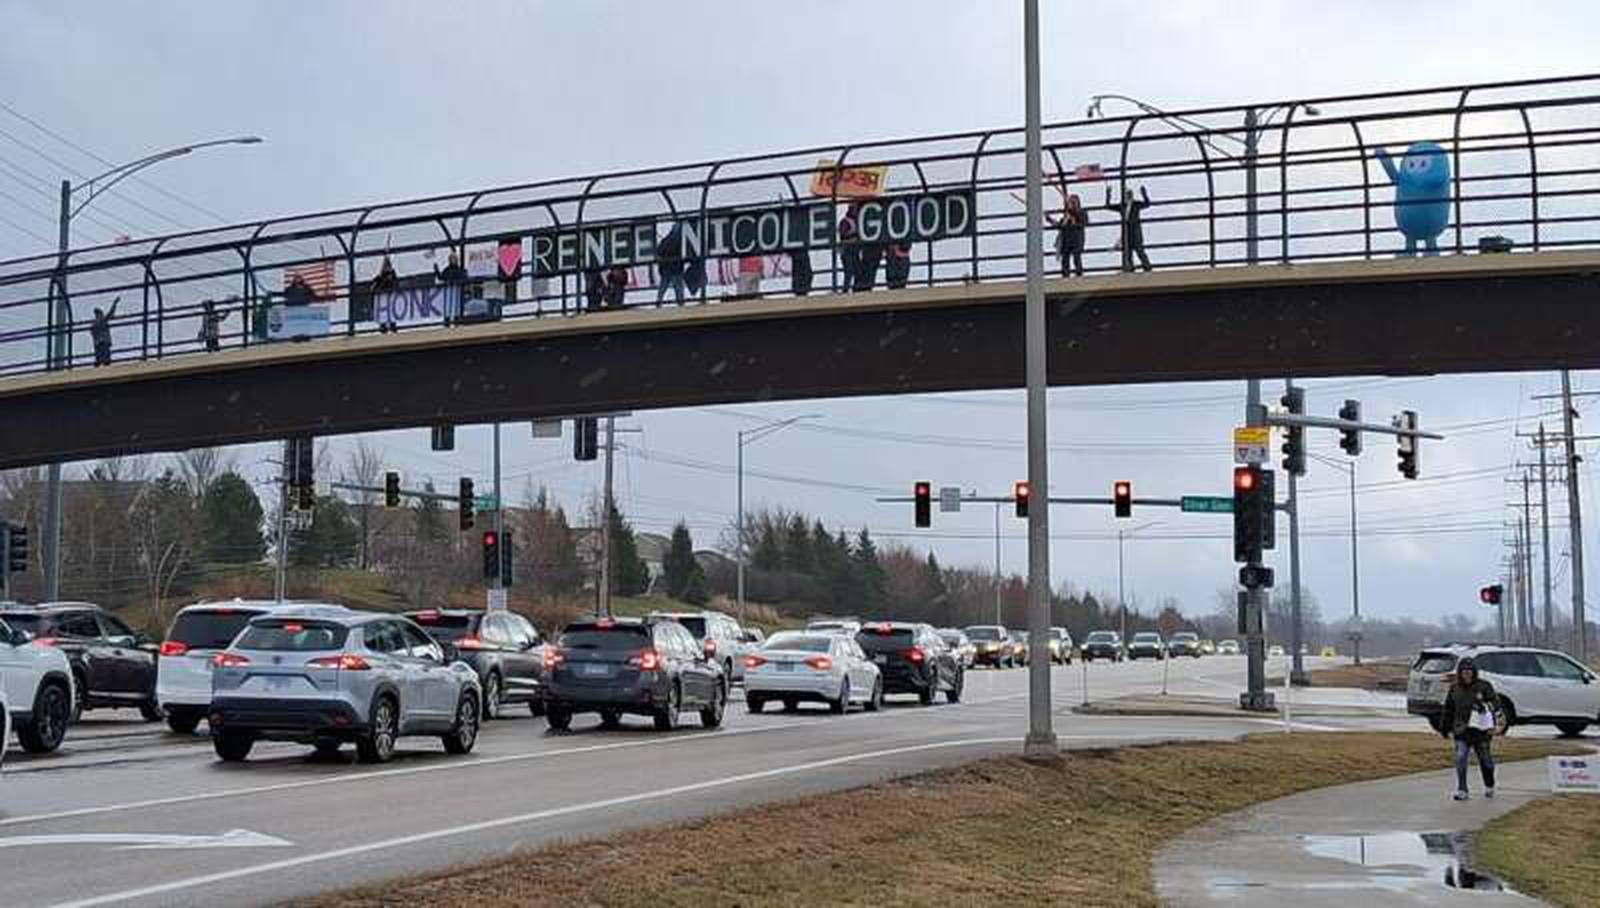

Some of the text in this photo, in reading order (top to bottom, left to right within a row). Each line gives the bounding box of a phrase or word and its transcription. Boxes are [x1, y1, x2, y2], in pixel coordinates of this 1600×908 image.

[532, 224, 656, 272] RENEE
[681, 206, 831, 256] NICOLE
[858, 195, 970, 242] GOOD
